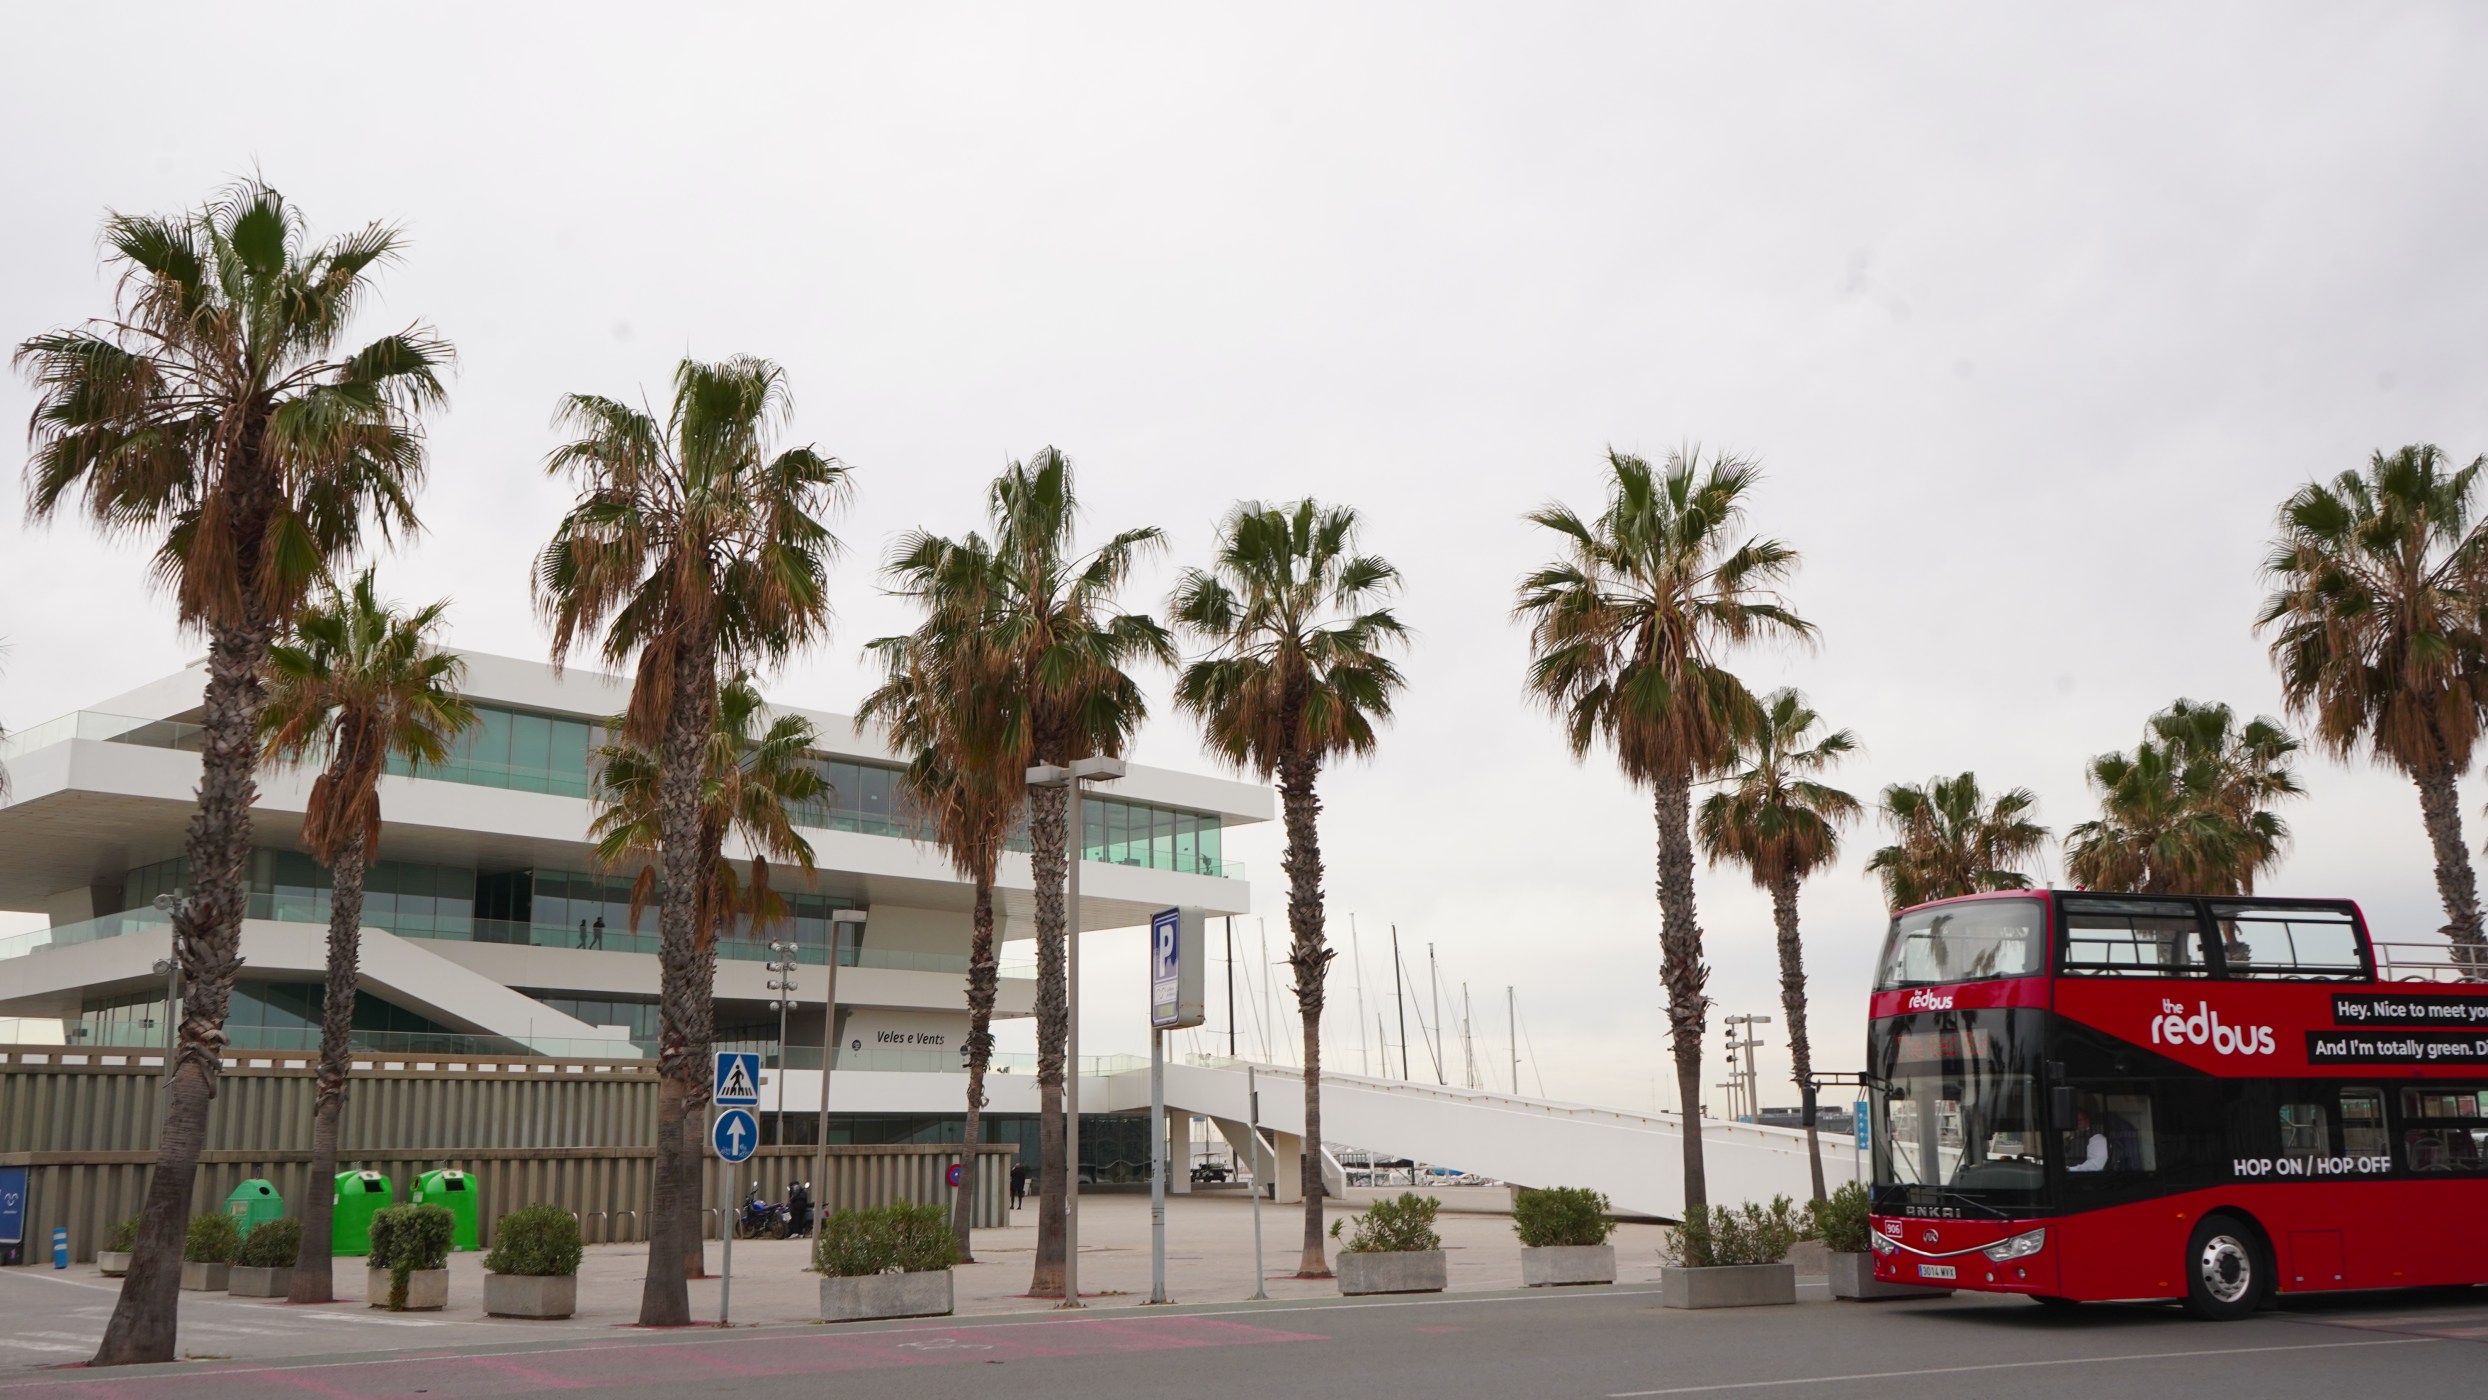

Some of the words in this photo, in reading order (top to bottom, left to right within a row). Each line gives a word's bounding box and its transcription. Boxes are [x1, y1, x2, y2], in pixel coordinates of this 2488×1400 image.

[1159, 924, 1174, 978] P
[2162, 998, 2184, 1014] the
[2337, 1001, 2371, 1020] Hey.
[2373, 1001, 2407, 1017] Nice
[2409, 1003, 2425, 1018] to
[2428, 1004, 2467, 1018] meet
[2468, 1006, 2488, 1022] yo
[877, 1030, 905, 1044] Veles
[907, 1034, 914, 1044] e
[916, 1032, 945, 1046] Vents
[2315, 1040, 2347, 1056] And
[2376, 1040, 2425, 1059] totally
[2427, 1043, 2474, 1060] green.
[2233, 1158, 2272, 1176] HOP
[2276, 1158, 2302, 1175] ON
[2306, 1154, 2314, 1177] /
[2317, 1157, 2354, 1175] HOP
[2358, 1156, 2391, 1173] OFF
[1906, 1205, 1961, 1218] ANKAI
[1887, 1223, 1901, 1234] 906
